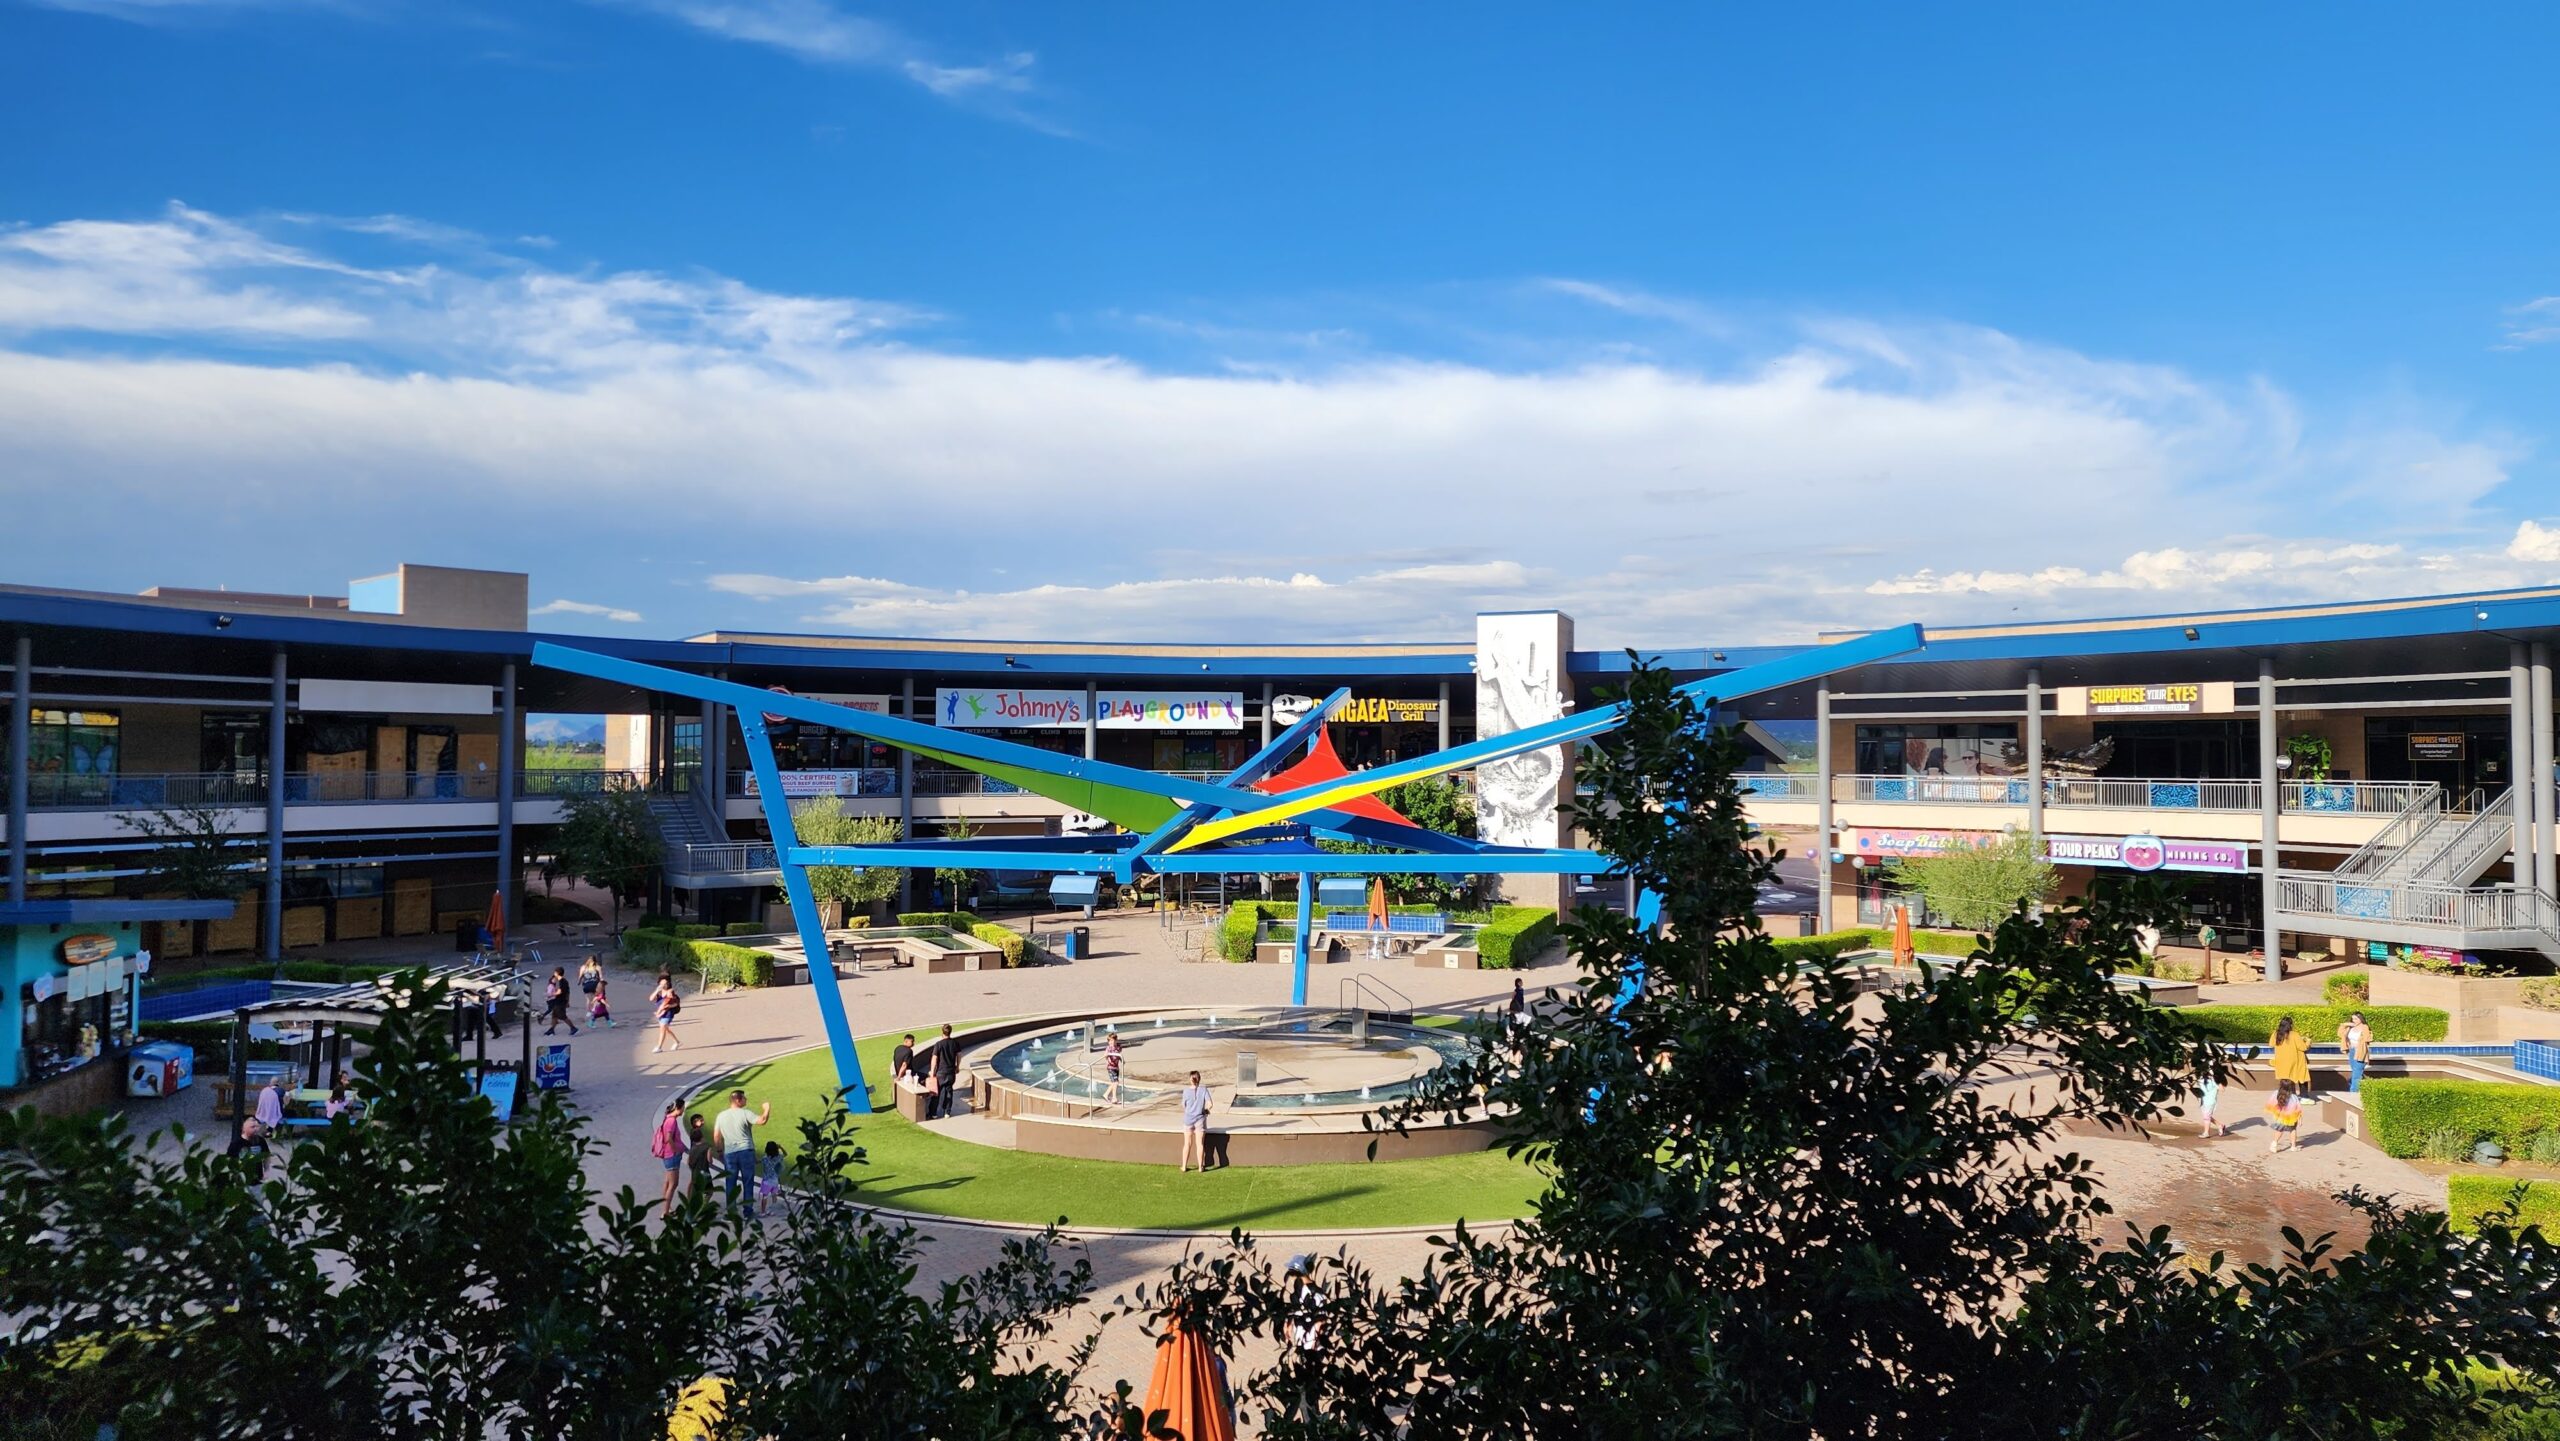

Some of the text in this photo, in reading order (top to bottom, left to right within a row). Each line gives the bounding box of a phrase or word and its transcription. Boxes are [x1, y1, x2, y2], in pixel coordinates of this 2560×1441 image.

[2090, 685, 2198, 704] SURPRISE YOUR EYES
[1312, 698, 1390, 723] NGAEA
[1387, 700, 1438, 711] Dinosaur
[1400, 710, 1425, 721] Grill
[799, 726, 827, 734] BURGERS
[1877, 833, 1916, 852] Soap
[2052, 842, 2120, 860] FOUR PEAKS
[2166, 849, 2233, 863] MINING CO.
